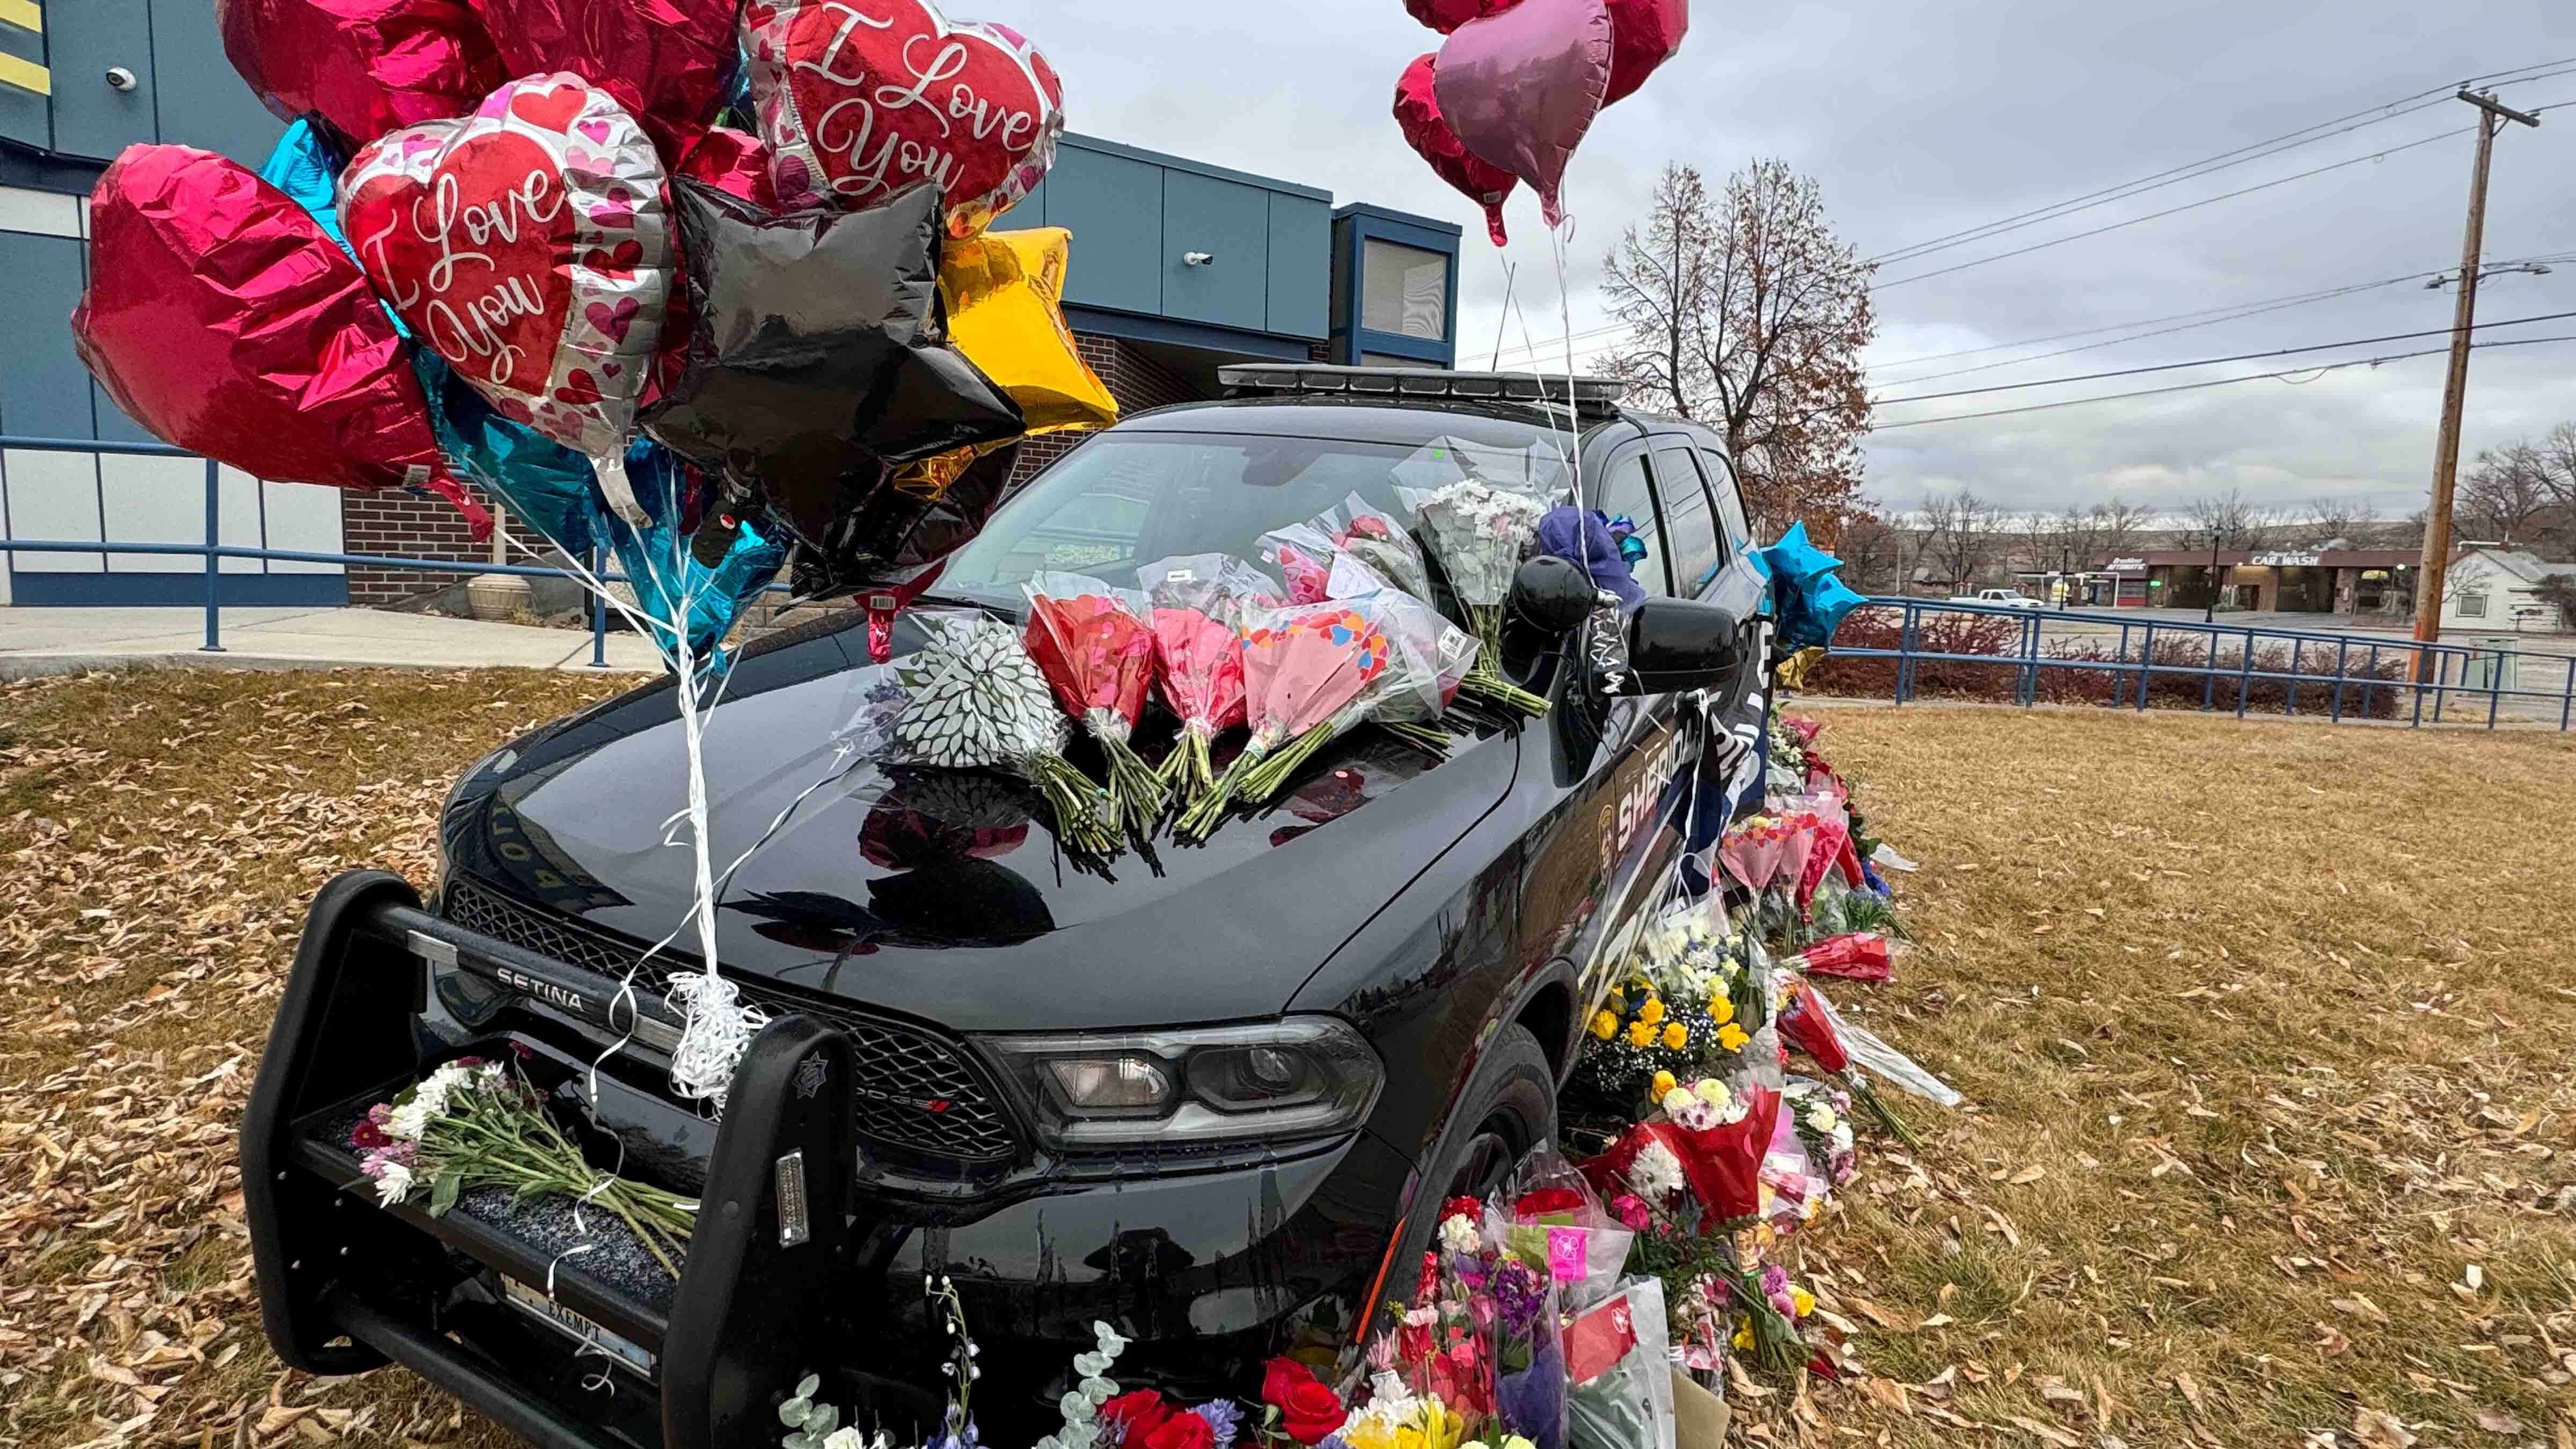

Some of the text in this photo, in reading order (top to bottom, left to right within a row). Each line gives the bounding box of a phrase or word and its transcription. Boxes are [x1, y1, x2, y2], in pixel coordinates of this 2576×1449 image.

[793, 2, 1033, 152] I Love
[817, 98, 965, 195] You
[362, 169, 567, 311] I Love
[427, 275, 544, 384] You
[2251, 556, 2319, 566] CAR WASH
[497, 967, 584, 1012] SETINA
[548, 1300, 601, 1341] EXEMPT
